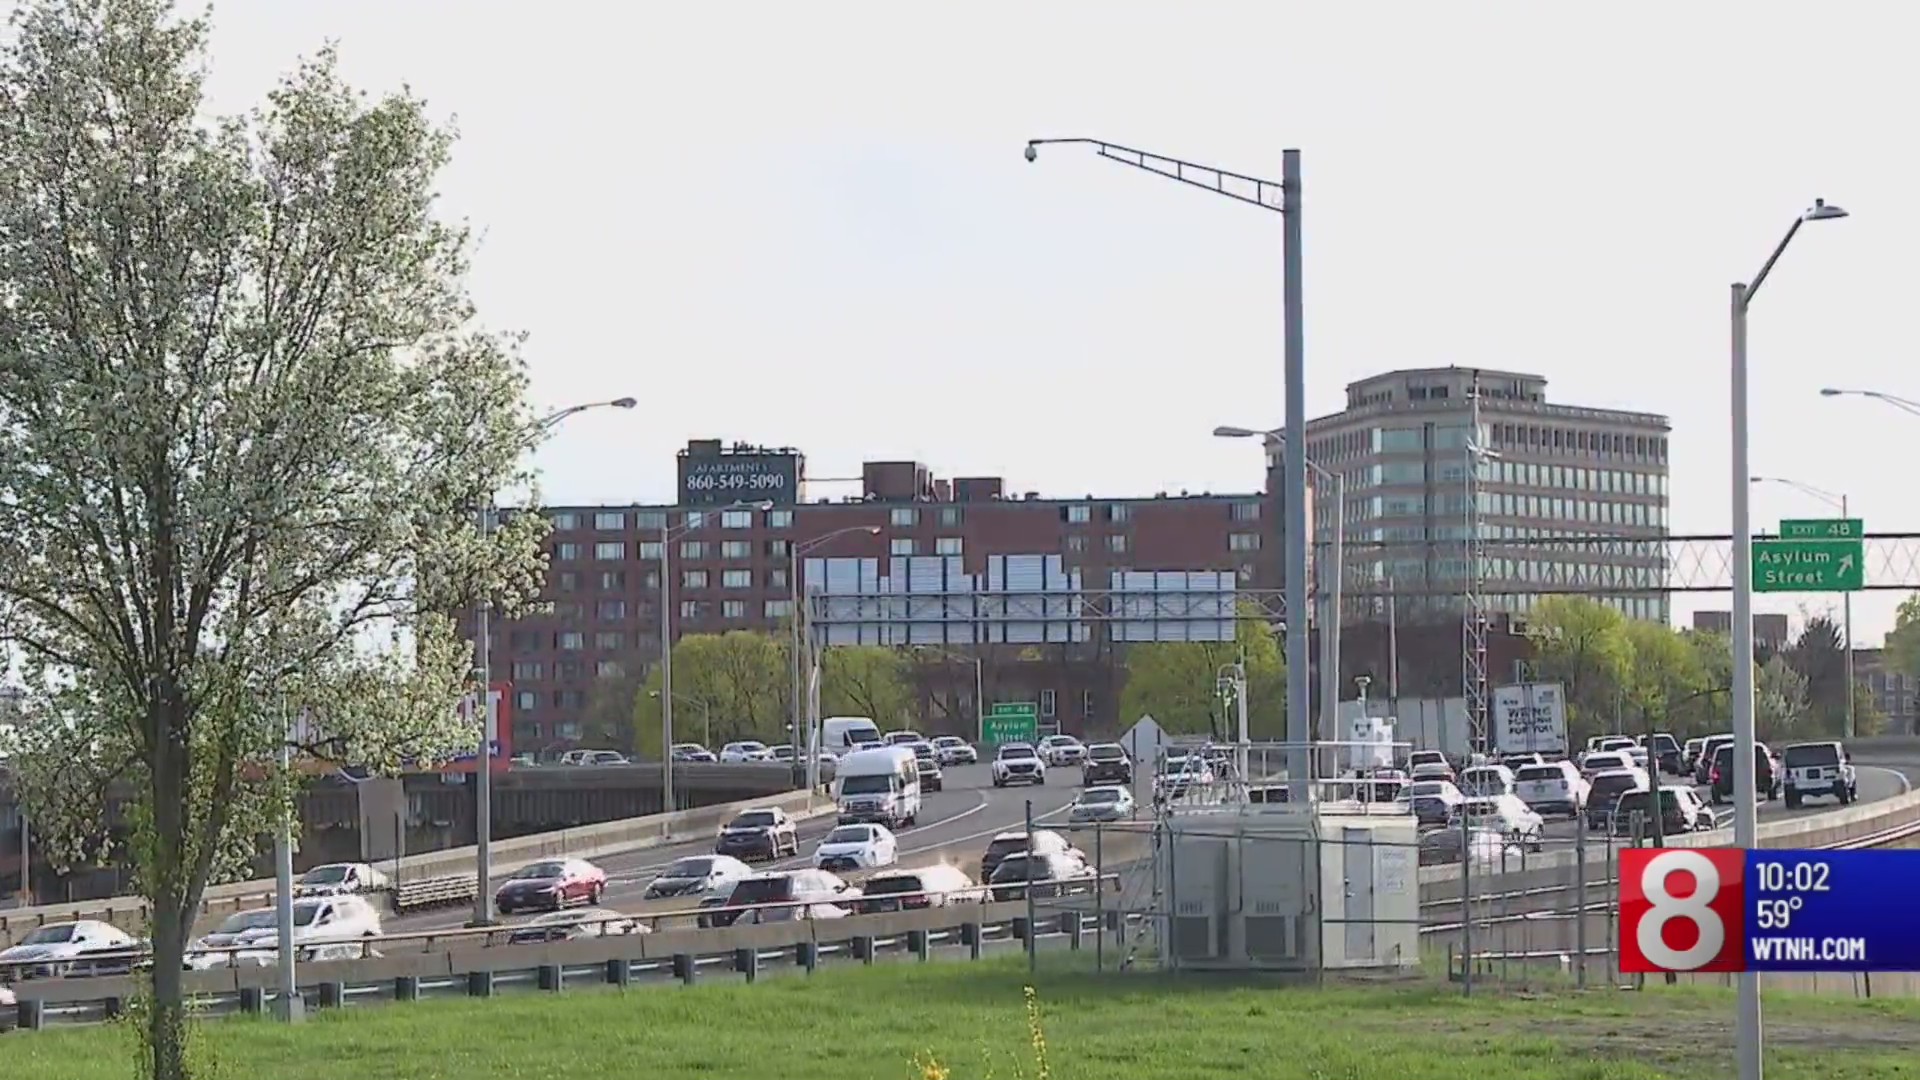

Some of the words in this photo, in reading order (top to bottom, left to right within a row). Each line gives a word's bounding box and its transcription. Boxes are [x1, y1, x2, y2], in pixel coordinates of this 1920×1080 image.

[687, 474, 784, 490] 860-549-5090
[1828, 521, 1850, 536] 48
[1759, 550, 1830, 566] Asylum
[1765, 569, 1823, 584] Street
